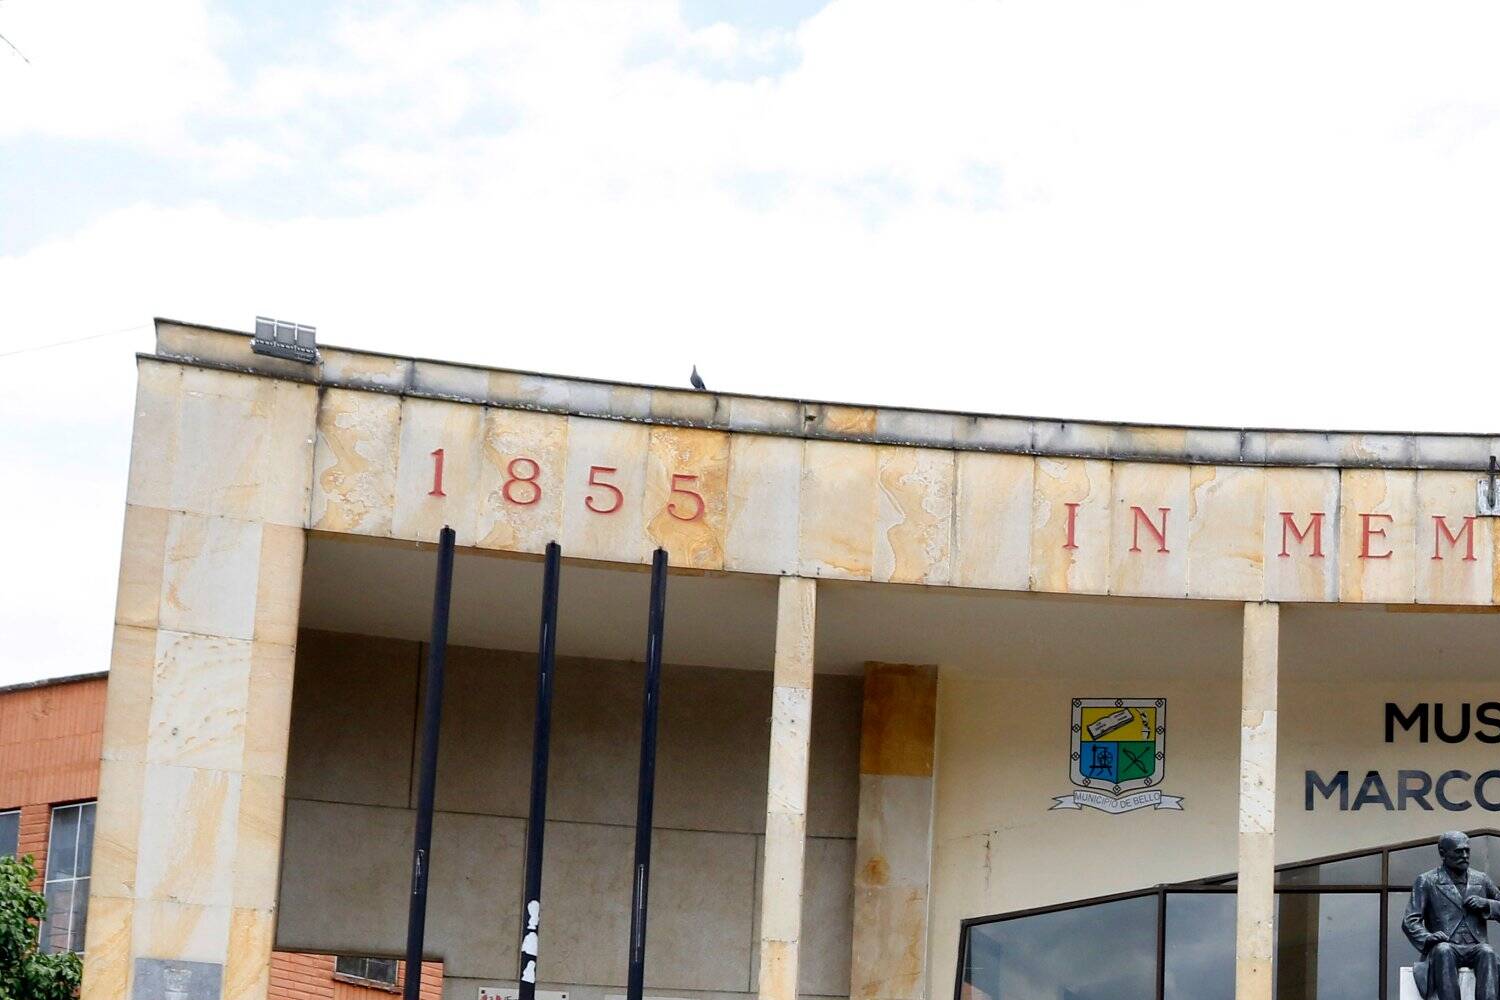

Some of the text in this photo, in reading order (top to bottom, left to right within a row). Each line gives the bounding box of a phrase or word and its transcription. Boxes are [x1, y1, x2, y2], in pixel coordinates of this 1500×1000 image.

[428, 448, 705, 521] 1855
[1062, 503, 1170, 553] IN
[1074, 792, 1161, 809] MUNICIPIO DE BELLO
